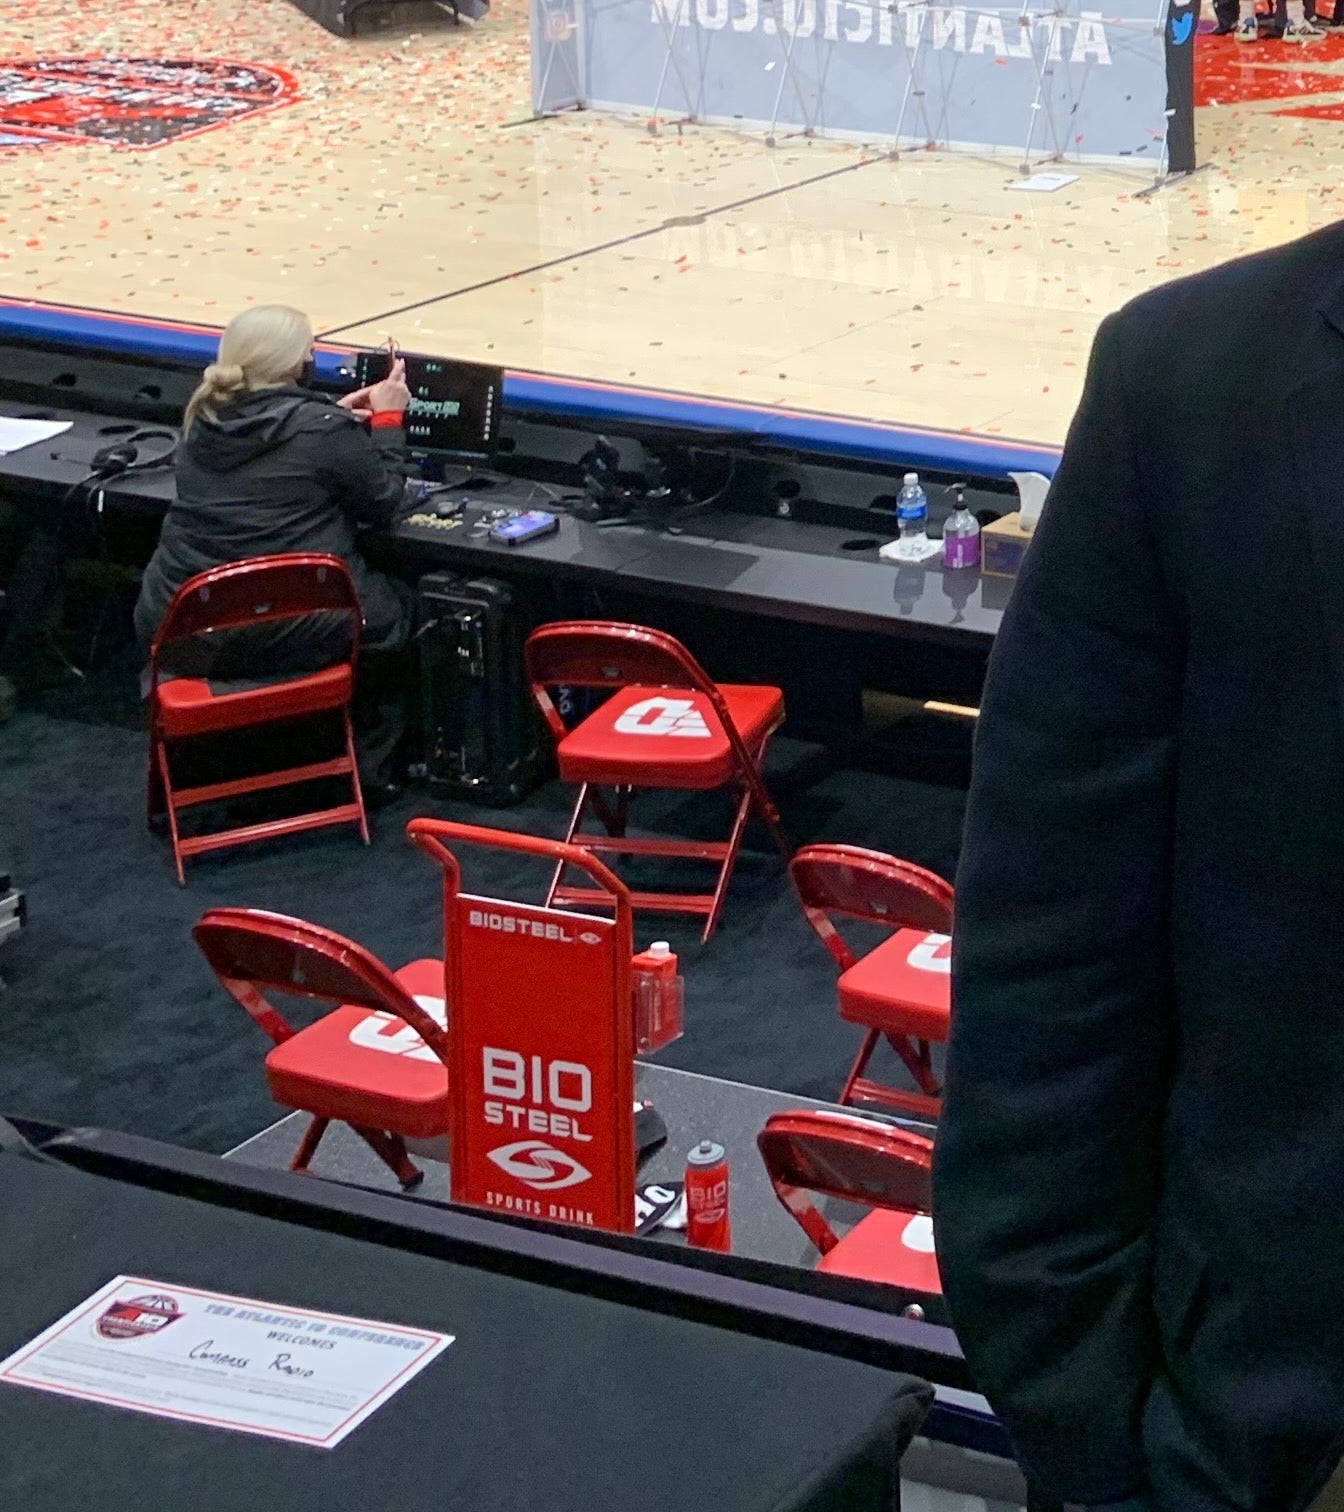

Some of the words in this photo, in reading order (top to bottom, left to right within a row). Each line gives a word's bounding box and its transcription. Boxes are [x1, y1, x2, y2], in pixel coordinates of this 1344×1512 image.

[470, 910, 573, 944] BIOSTEEL
[482, 1045, 593, 1112] BIO
[484, 1101, 594, 1142] STEEL
[486, 1191, 542, 1216] SPORTS
[549, 1204, 595, 1226] DRINK
[266, 1330, 338, 1350] WELCOMES
